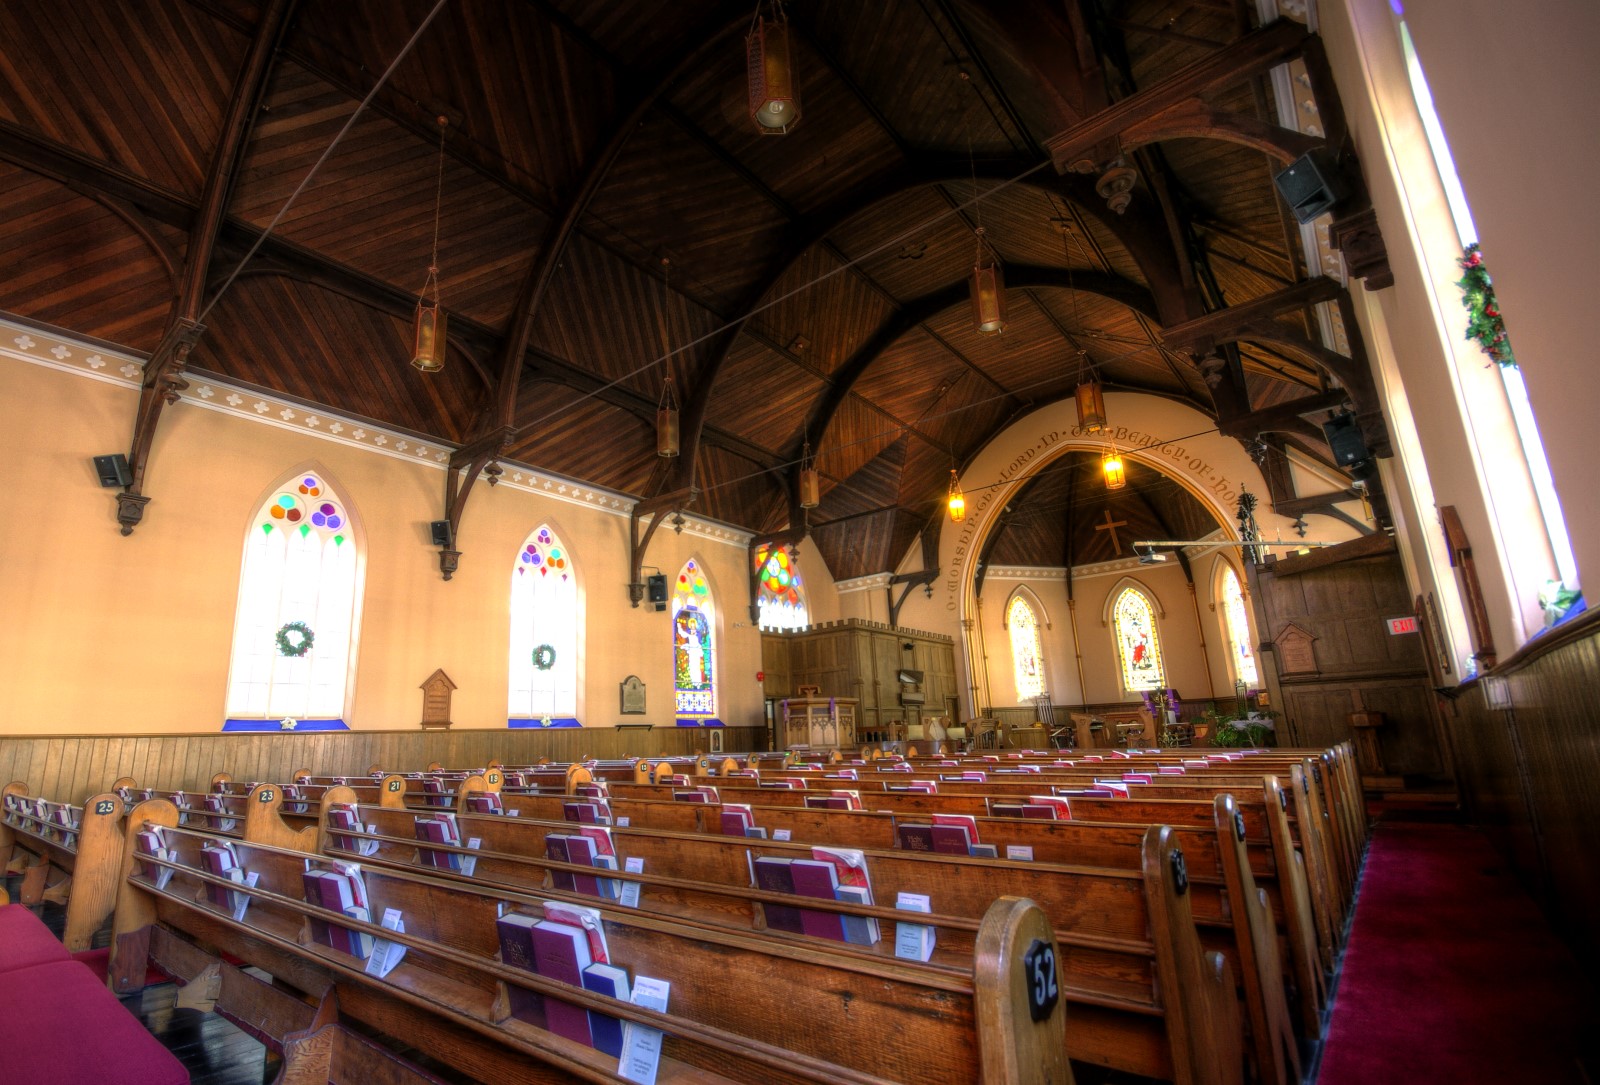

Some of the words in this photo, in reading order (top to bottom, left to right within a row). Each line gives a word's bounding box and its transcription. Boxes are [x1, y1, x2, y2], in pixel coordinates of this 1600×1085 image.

[1392, 617, 1415, 632] EXIT
[390, 781, 400, 791] 21
[261, 791, 273, 801] 23
[98, 802, 114, 813] 25
[1034, 948, 1057, 1006] 52
